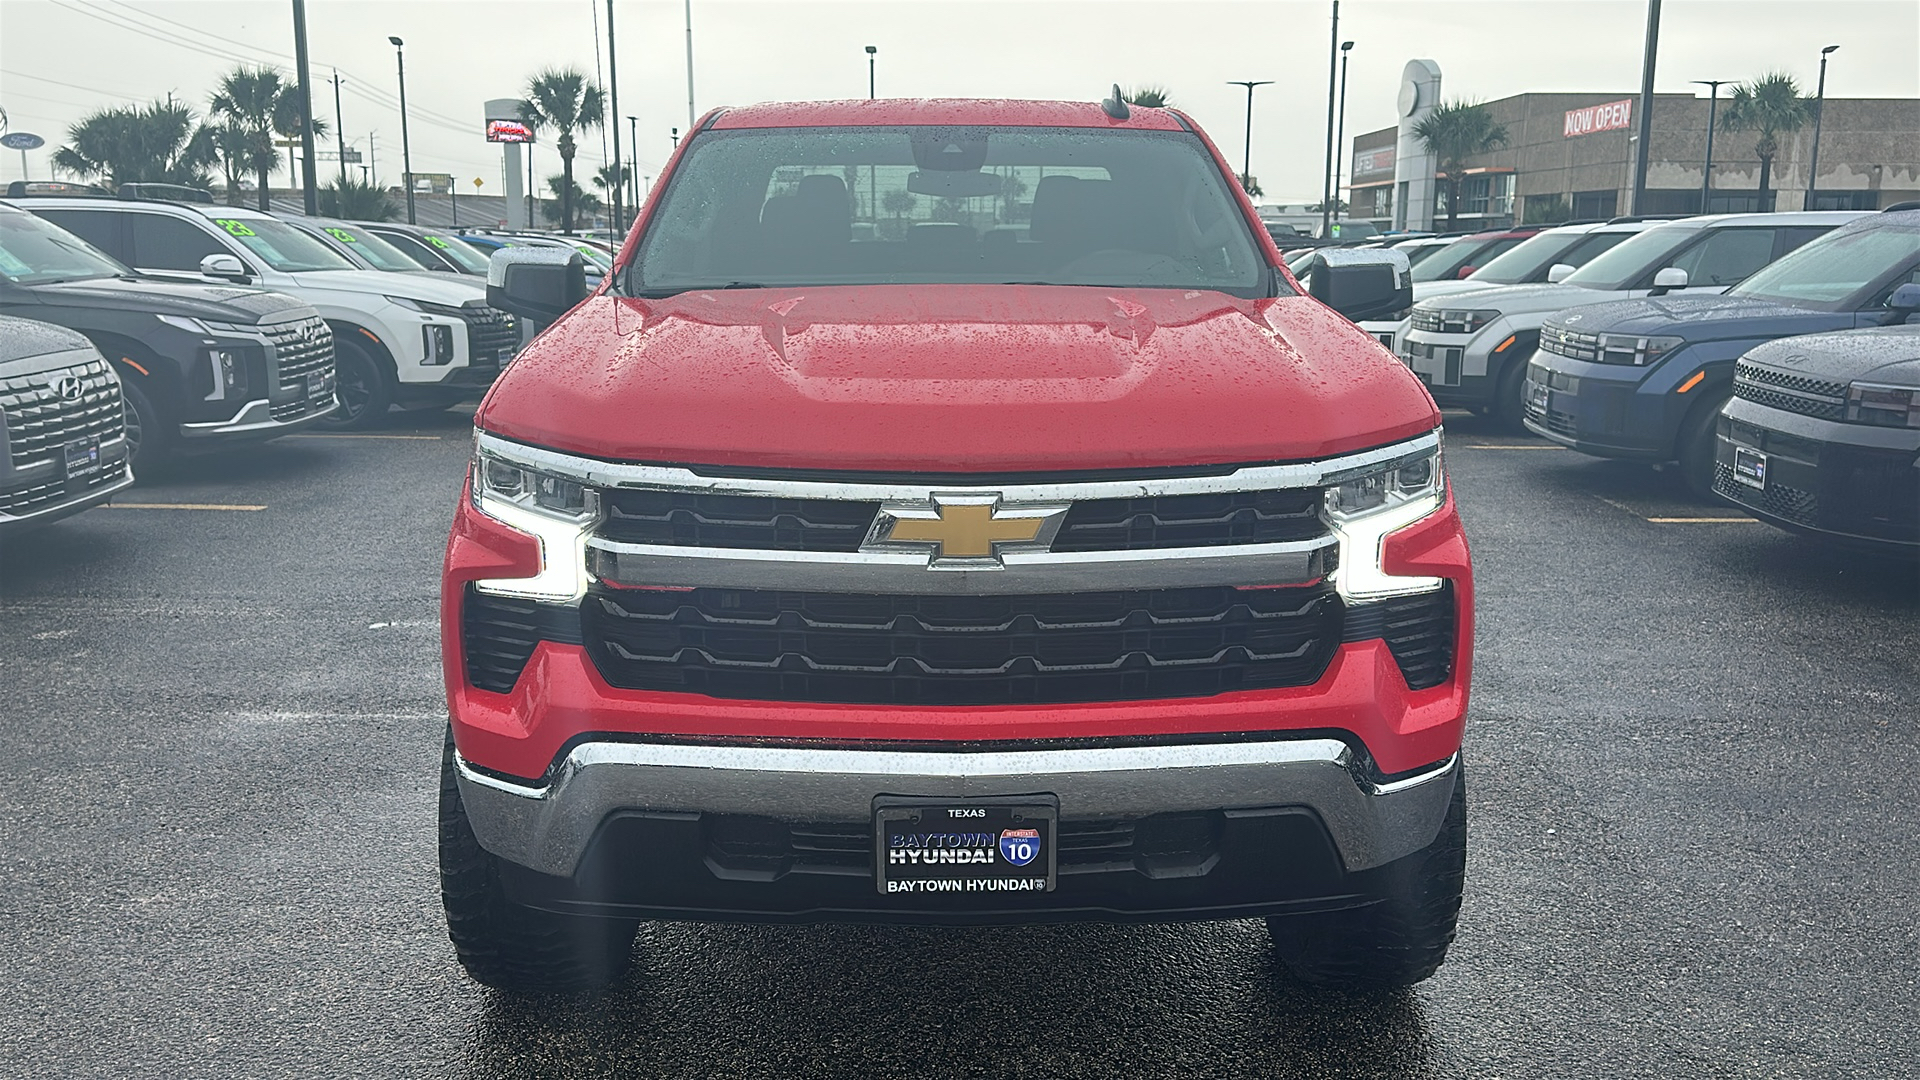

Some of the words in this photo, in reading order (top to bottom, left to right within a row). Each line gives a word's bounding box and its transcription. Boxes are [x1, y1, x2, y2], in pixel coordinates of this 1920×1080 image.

[1565, 110, 1593, 135] NOW
[1595, 102, 1630, 129] OPEN
[8, 136, 34, 147] Ford
[215, 219, 256, 236] 23
[948, 809, 986, 818] TEXAS
[889, 833, 995, 848] BAYTOWN
[889, 848, 994, 864] HYUNDAI
[1008, 844, 1032, 860] 10
[887, 880, 962, 893] BAYTOWN
[966, 878, 1034, 891] HYUNDAI
